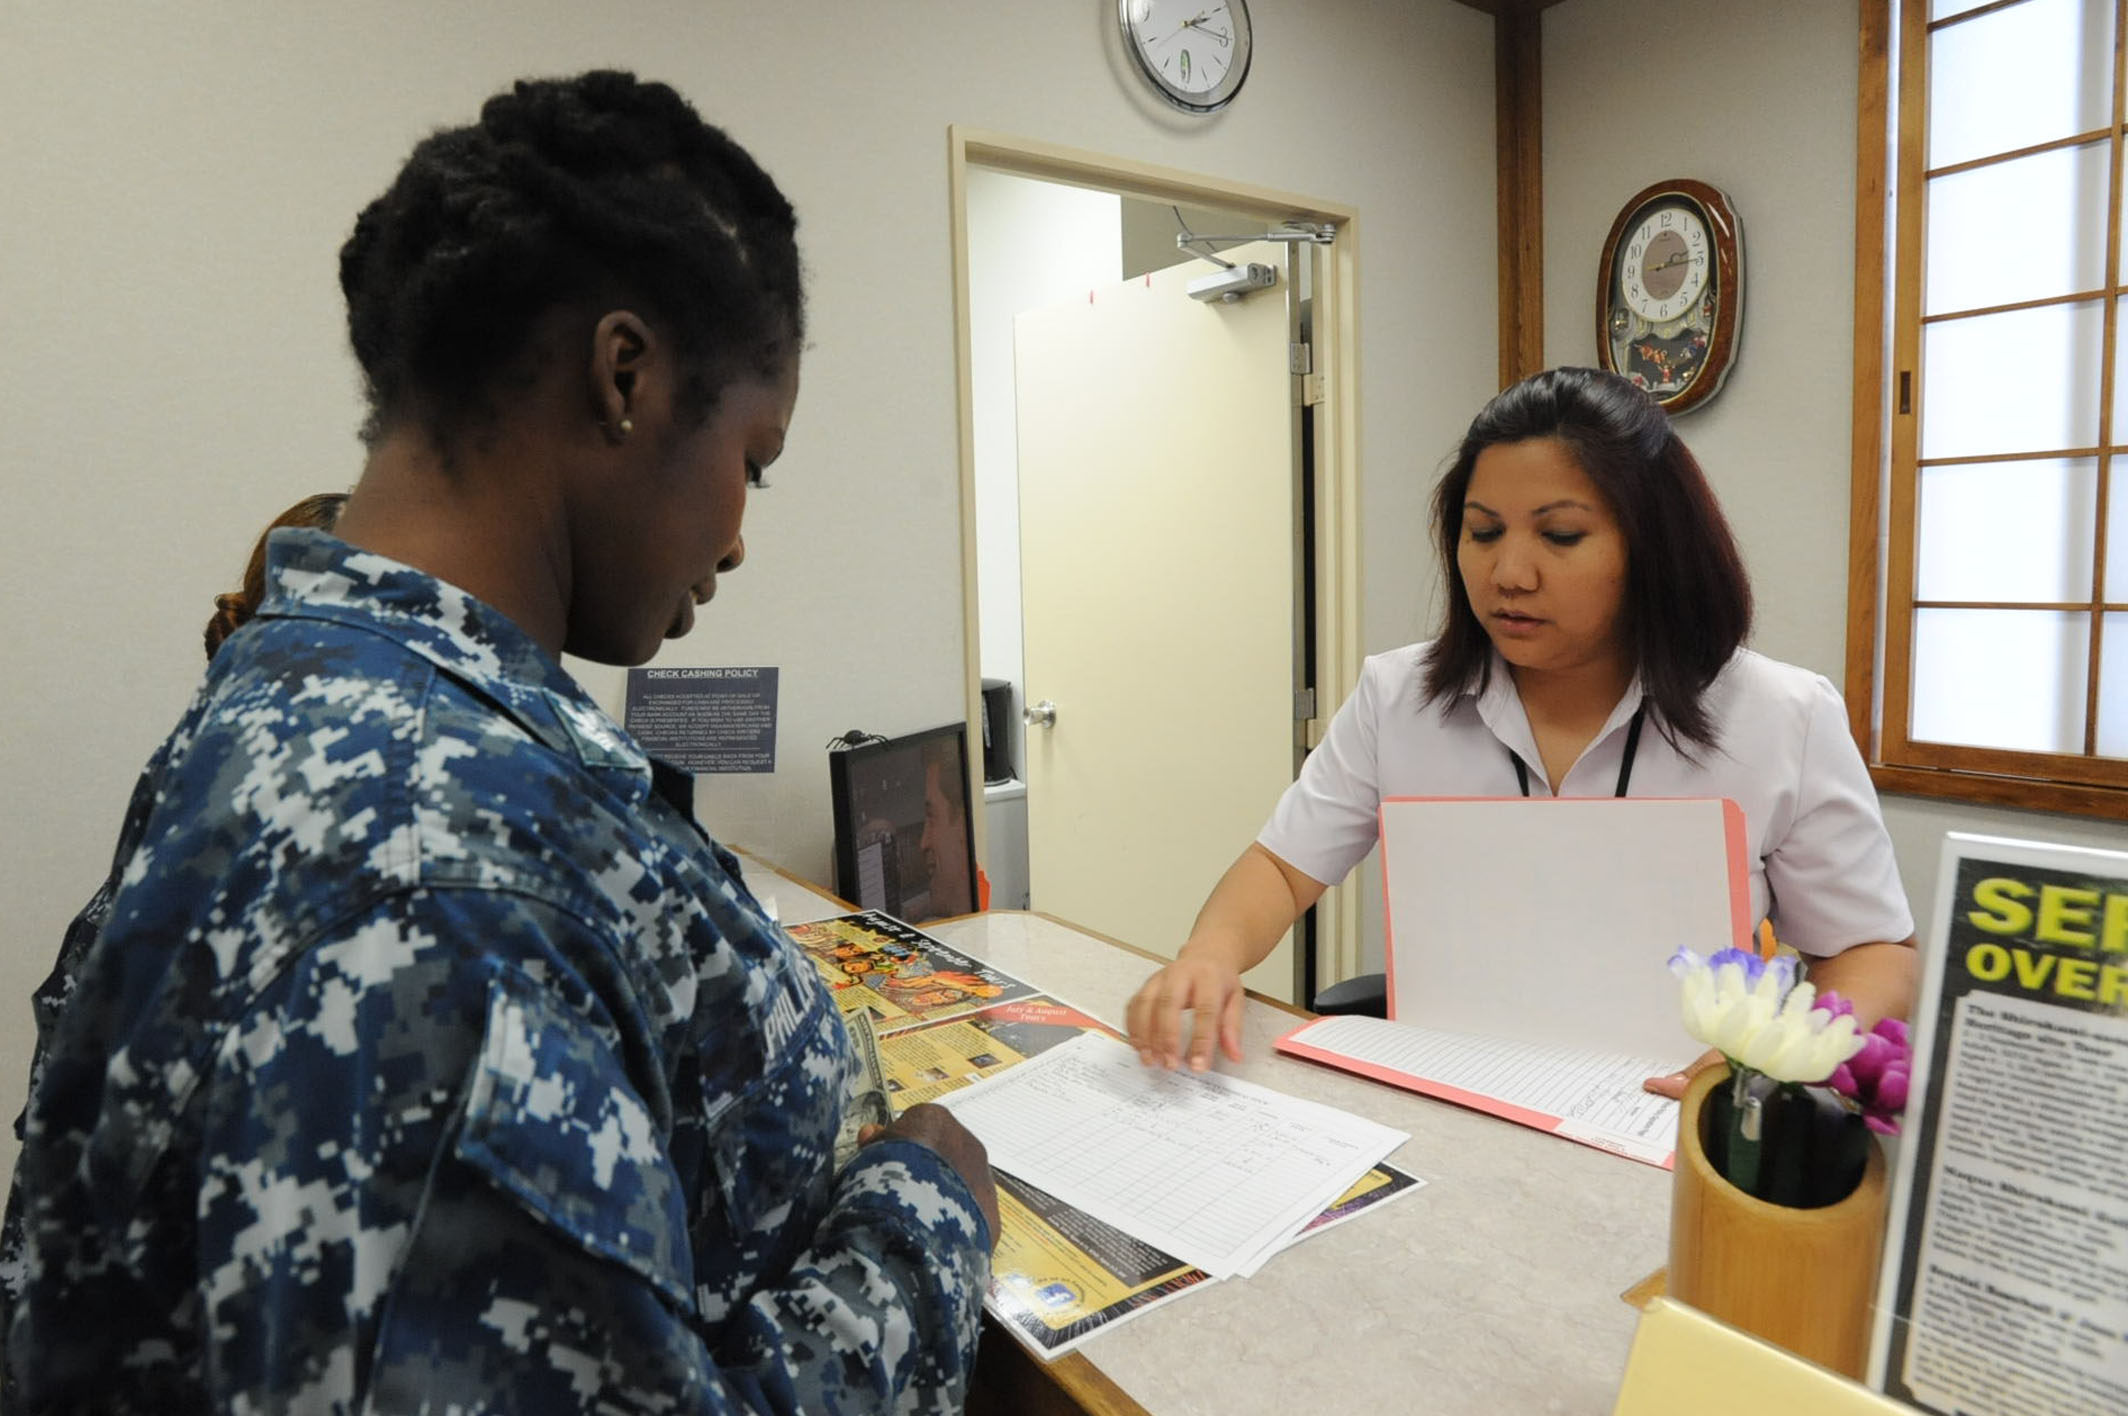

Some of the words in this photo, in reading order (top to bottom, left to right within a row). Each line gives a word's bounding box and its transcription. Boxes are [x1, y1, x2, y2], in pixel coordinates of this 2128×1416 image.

[1661, 212, 1672, 228] 12
[1641, 226, 1651, 240] 11
[1691, 231, 1702, 247] 2
[1630, 244, 1641, 258] 10
[1627, 266, 1635, 279] 9
[1690, 272, 1699, 287] 4
[1631, 284, 1639, 299] 8
[1680, 291, 1688, 306] 5
[1641, 299, 1649, 313] 7
[1660, 304, 1668, 318] 6
[647, 670, 679, 679] CHECK
[681, 669, 722, 679] CASHING
[725, 668, 759, 679] POLICY
